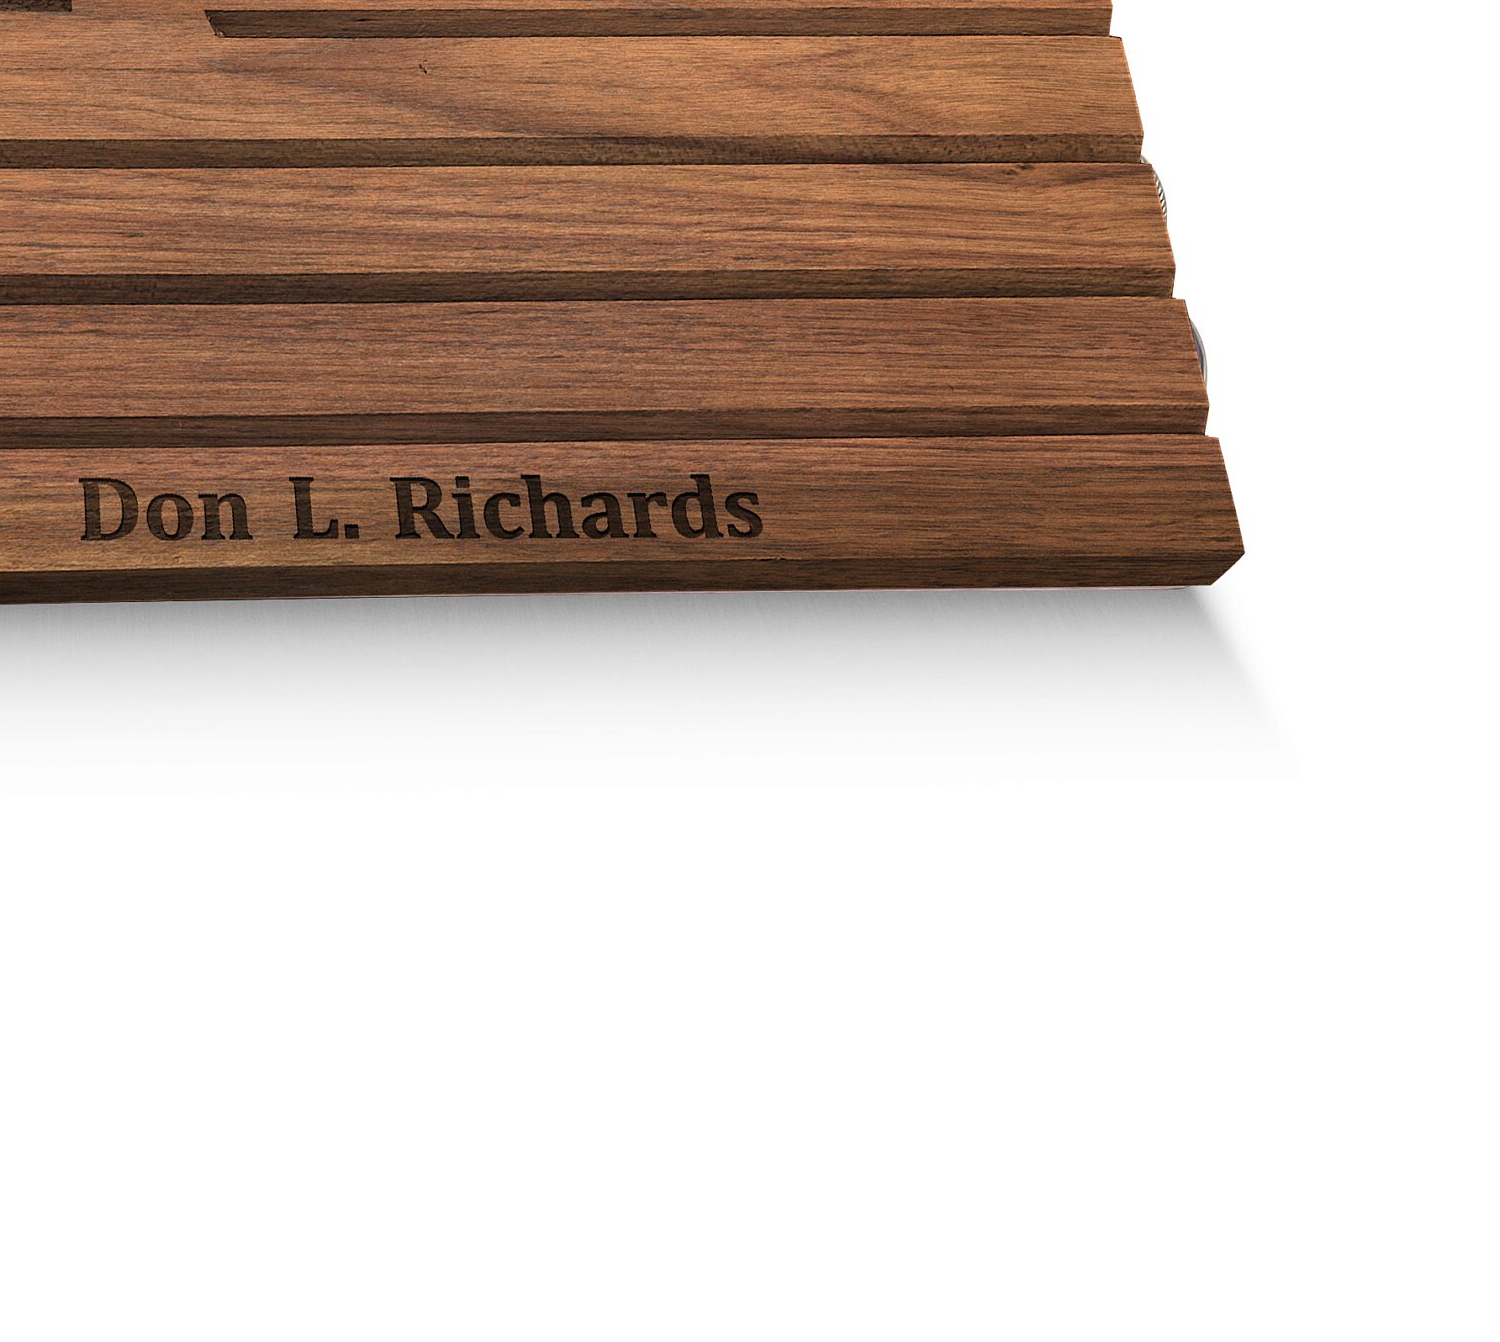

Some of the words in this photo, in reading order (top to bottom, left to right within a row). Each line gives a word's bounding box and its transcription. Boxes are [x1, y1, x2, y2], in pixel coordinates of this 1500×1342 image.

[78, 476, 254, 541] Don
[288, 476, 360, 541] L.
[390, 473, 764, 542] Richards
